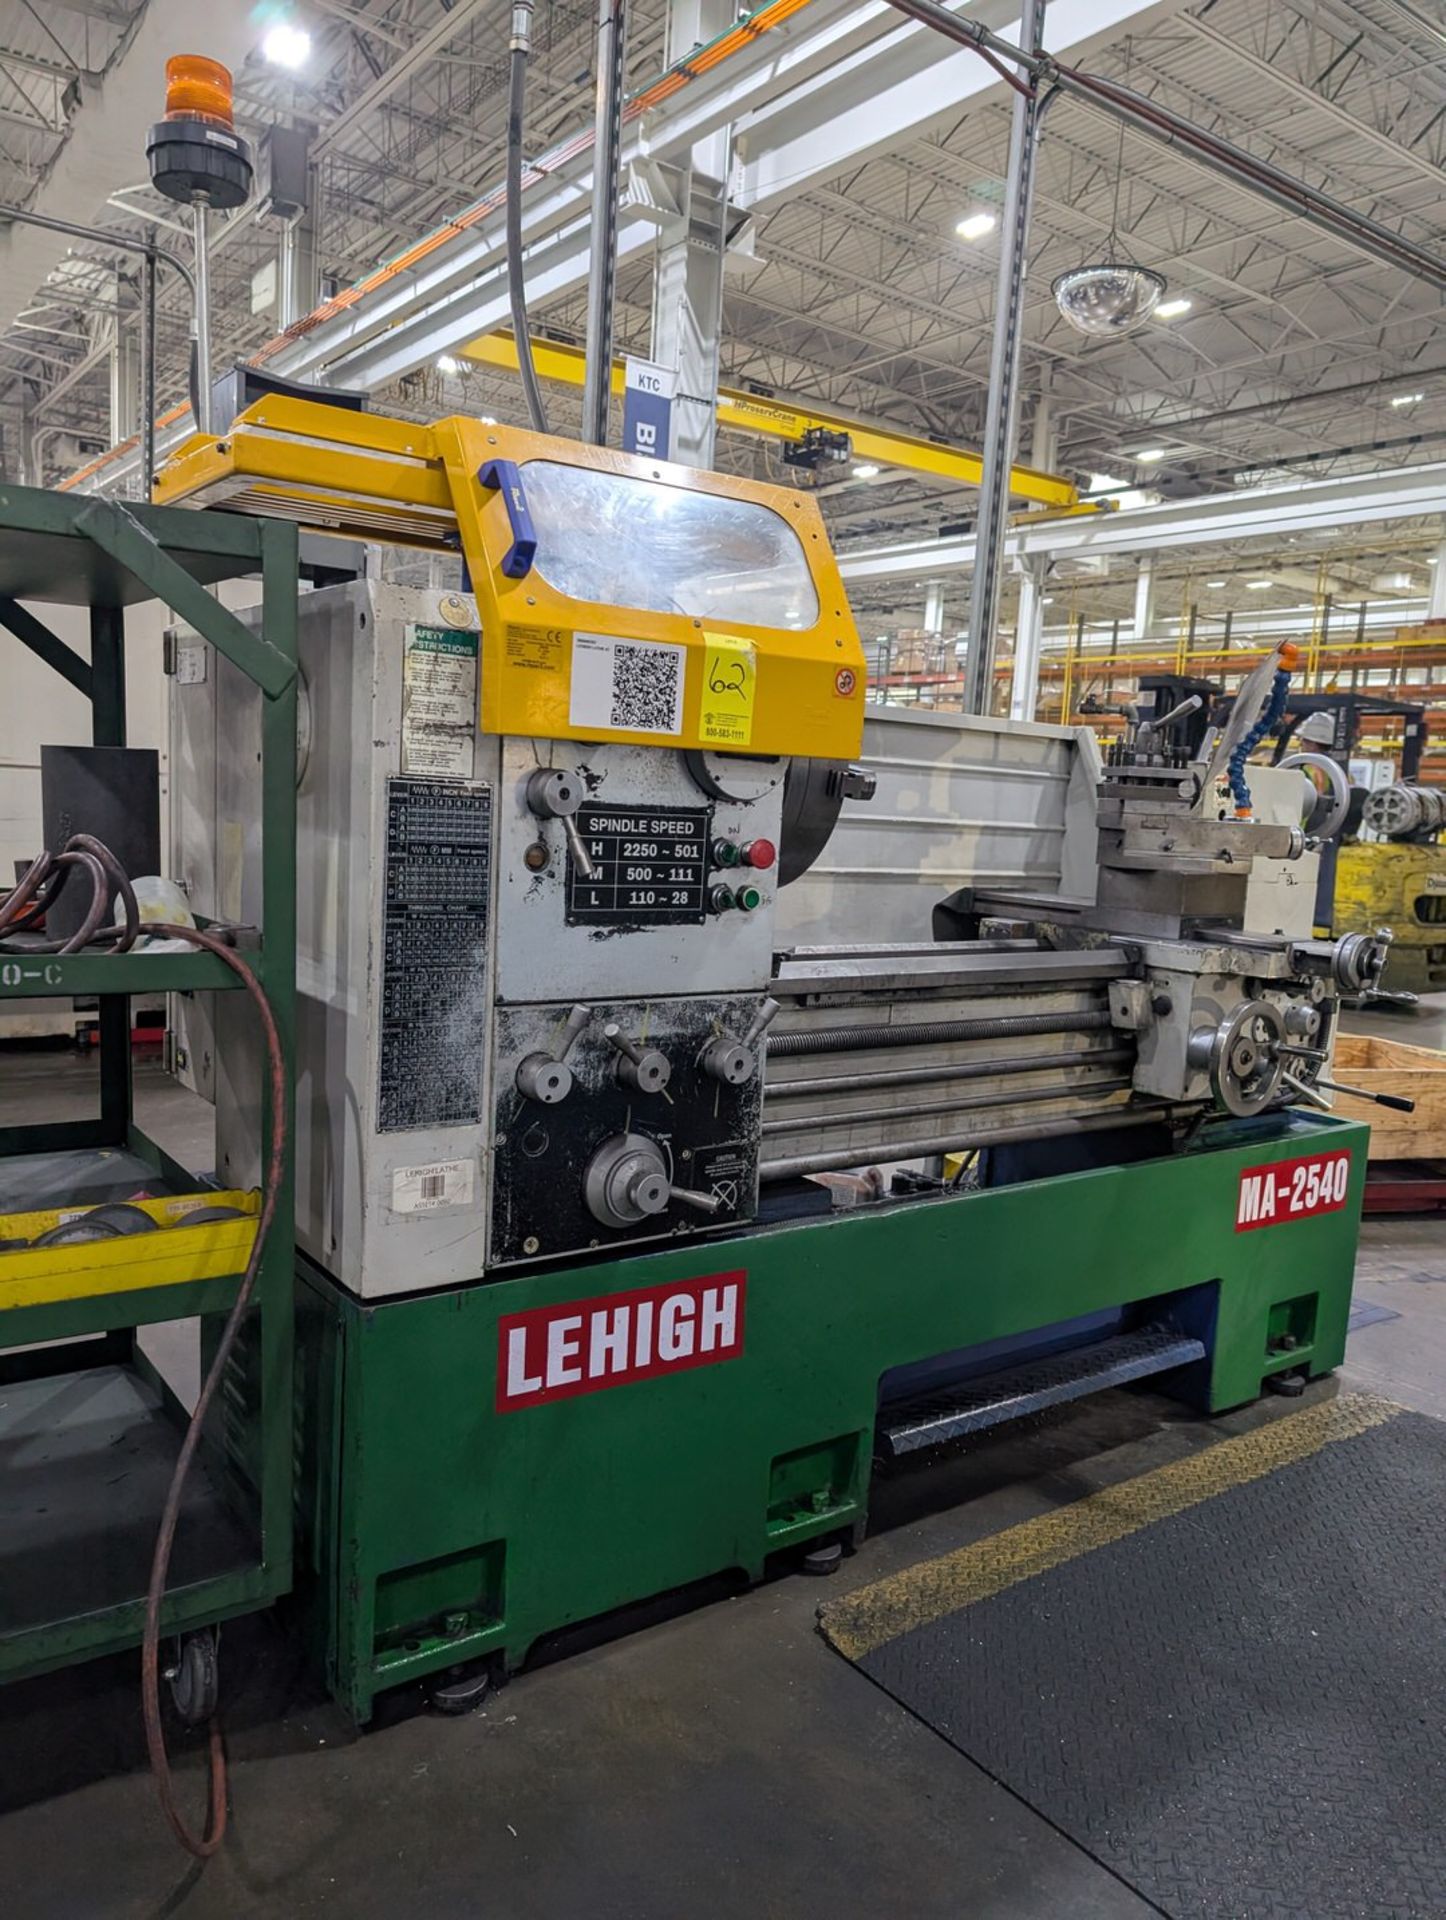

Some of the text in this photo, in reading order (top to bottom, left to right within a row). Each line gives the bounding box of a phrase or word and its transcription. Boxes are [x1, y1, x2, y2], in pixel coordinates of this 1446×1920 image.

[638, 373, 660, 392] KTC
[635, 421, 656, 458] BI
[709, 656, 747, 701] 62
[589, 817, 694, 835] SPINDLE SPEED
[591, 842, 603, 855] H
[623, 843, 657, 857] 2250
[674, 845, 699, 858] 501
[589, 867, 603, 880] M
[627, 867, 651, 881] 500
[668, 868, 694, 881] 111
[591, 891, 599, 905] L
[629, 891, 655, 905] 110
[672, 891, 688, 904] 28
[1237, 1157, 1348, 1224] MA-2540
[507, 1284, 738, 1397] LEHIGH
